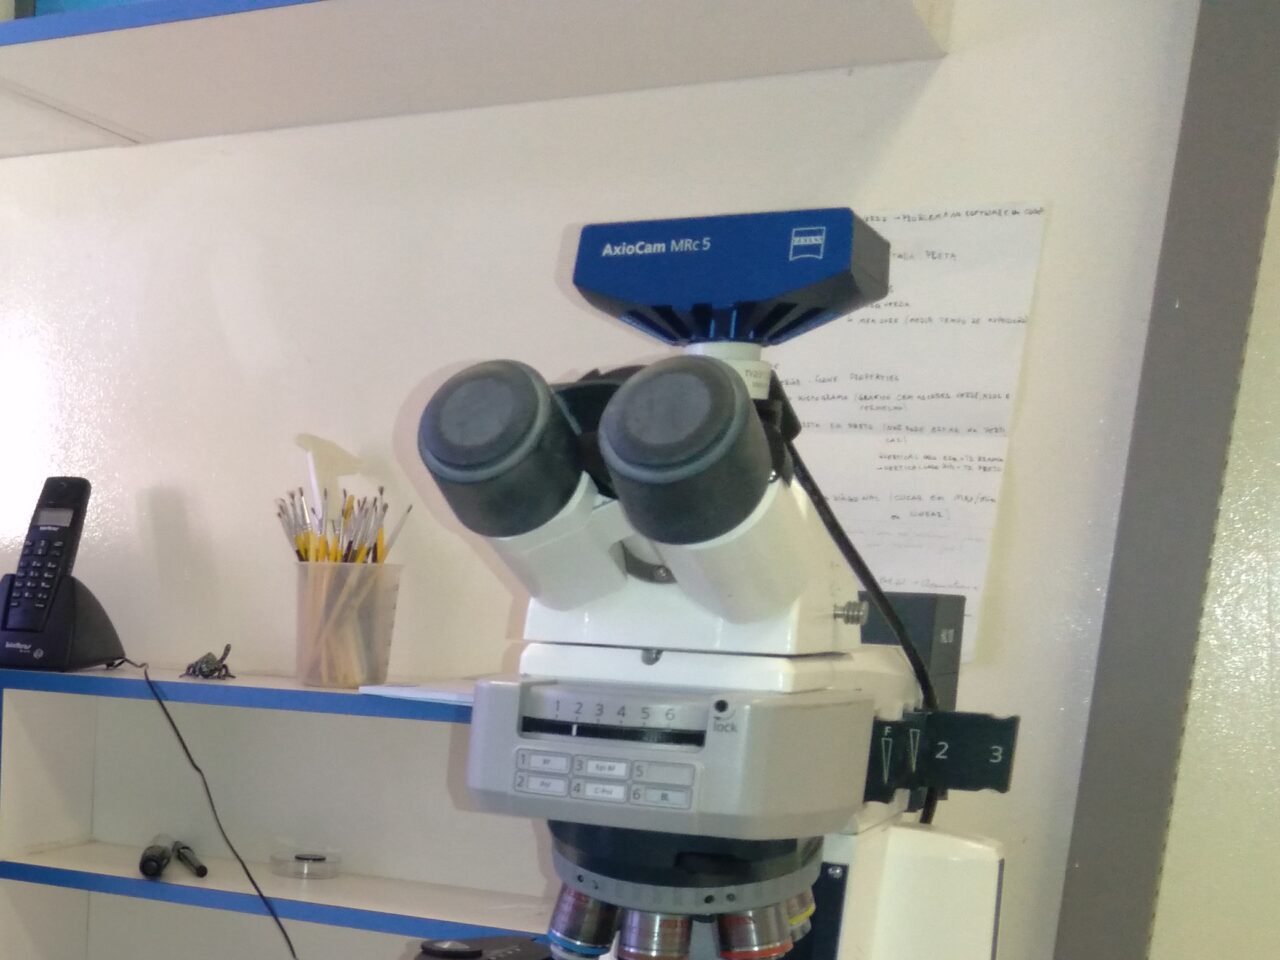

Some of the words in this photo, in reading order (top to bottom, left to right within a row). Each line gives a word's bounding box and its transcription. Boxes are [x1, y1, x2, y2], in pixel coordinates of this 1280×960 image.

[602, 241, 666, 256] AxioCam
[670, 239, 700, 252] MRc
[702, 237, 712, 251] 5
[554, 699, 561, 711] 1
[573, 702, 583, 715] 2
[595, 704, 604, 717] 3
[616, 706, 627, 718] 4
[641, 707, 650, 720] 5
[665, 708, 676, 721] 6
[712, 720, 739, 734] lock
[884, 726, 893, 737] F
[935, 741, 950, 760] 2
[989, 745, 1004, 763] 3
[576, 759, 584, 772] 3
[635, 765, 644, 778] 5
[517, 775, 525, 788] 2
[572, 782, 581, 793] 4
[632, 788, 641, 800] 6
